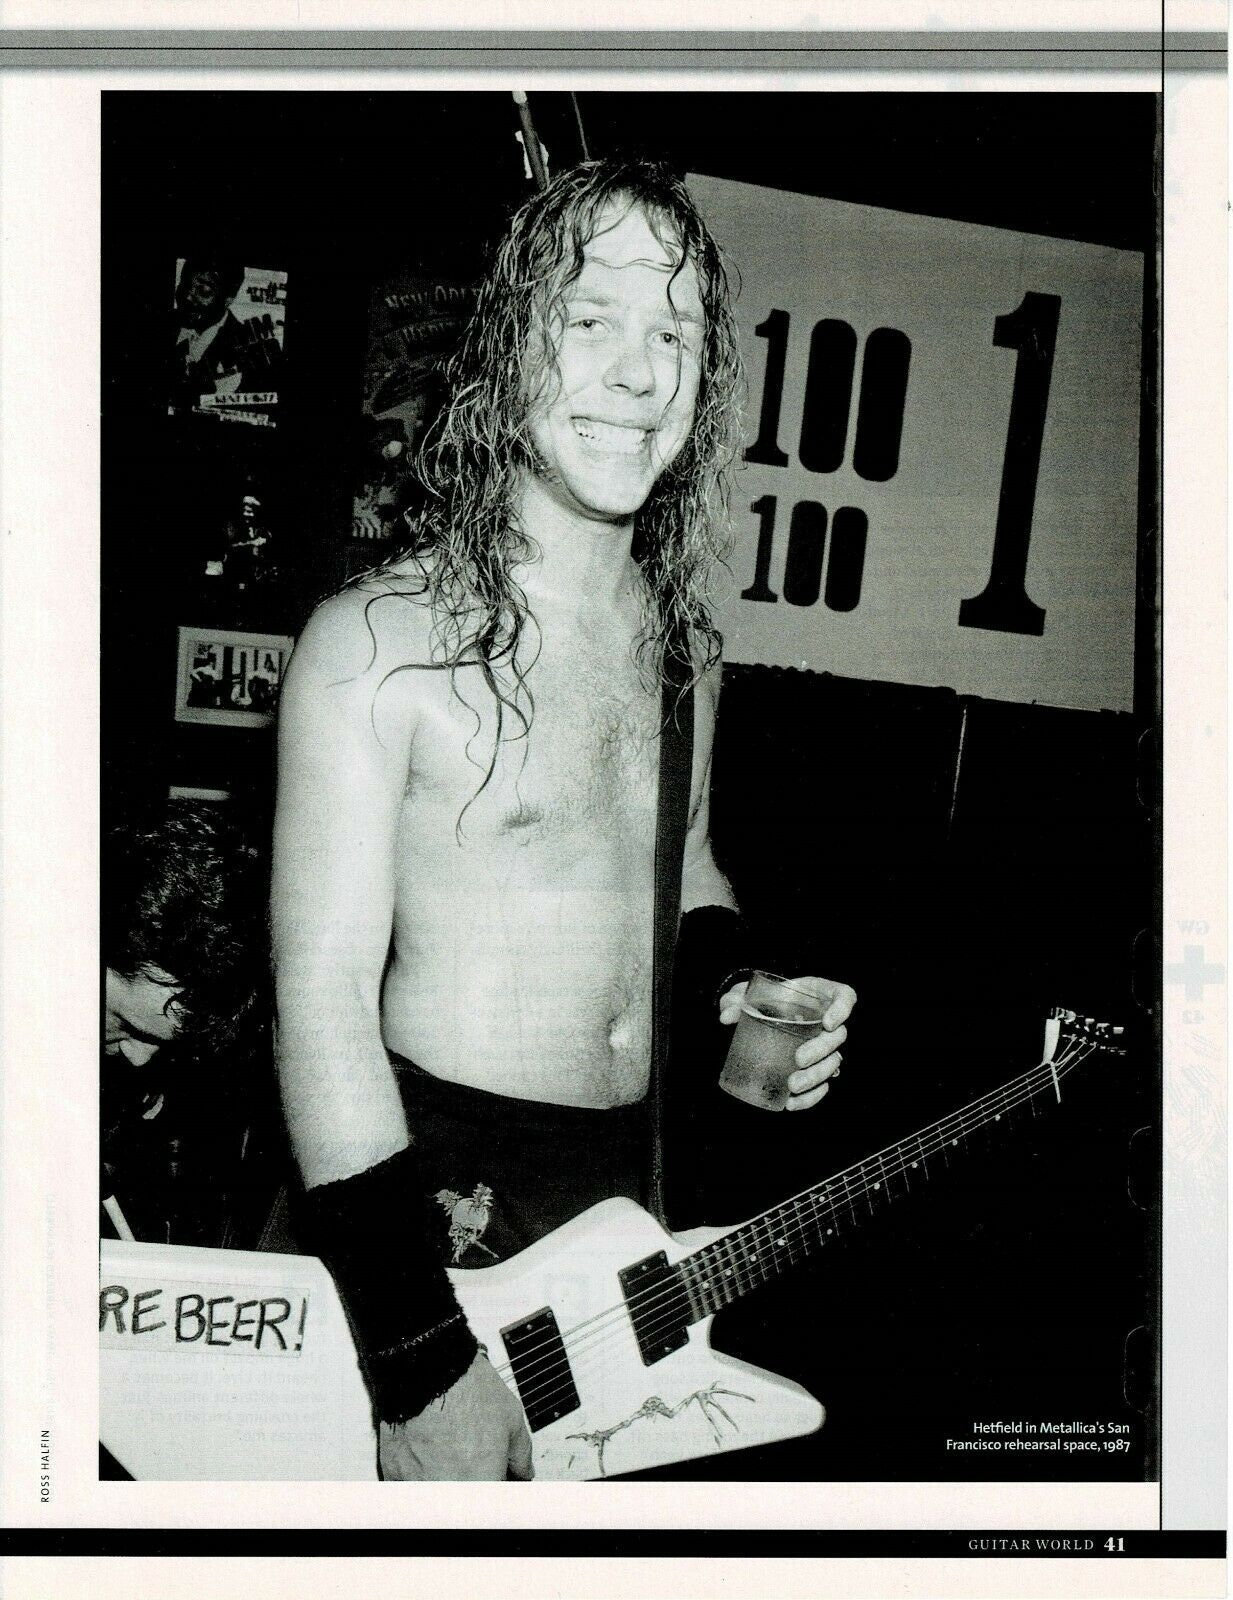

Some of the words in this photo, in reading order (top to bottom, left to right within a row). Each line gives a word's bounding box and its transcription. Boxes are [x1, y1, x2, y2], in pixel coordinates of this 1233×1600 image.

[742, 308, 913, 482] 100
[958, 291, 1061, 636] 1
[740, 494, 869, 613] 100
[174, 1293, 307, 1352] BEER!
[40, 1430, 50, 1470] HALFIN
[40, 1475, 50, 1504] ROSS
[968, 1539, 1031, 1550] GUITAR
[1035, 1539, 1095, 1550] WORLD
[1103, 1536, 1126, 1552] 41
